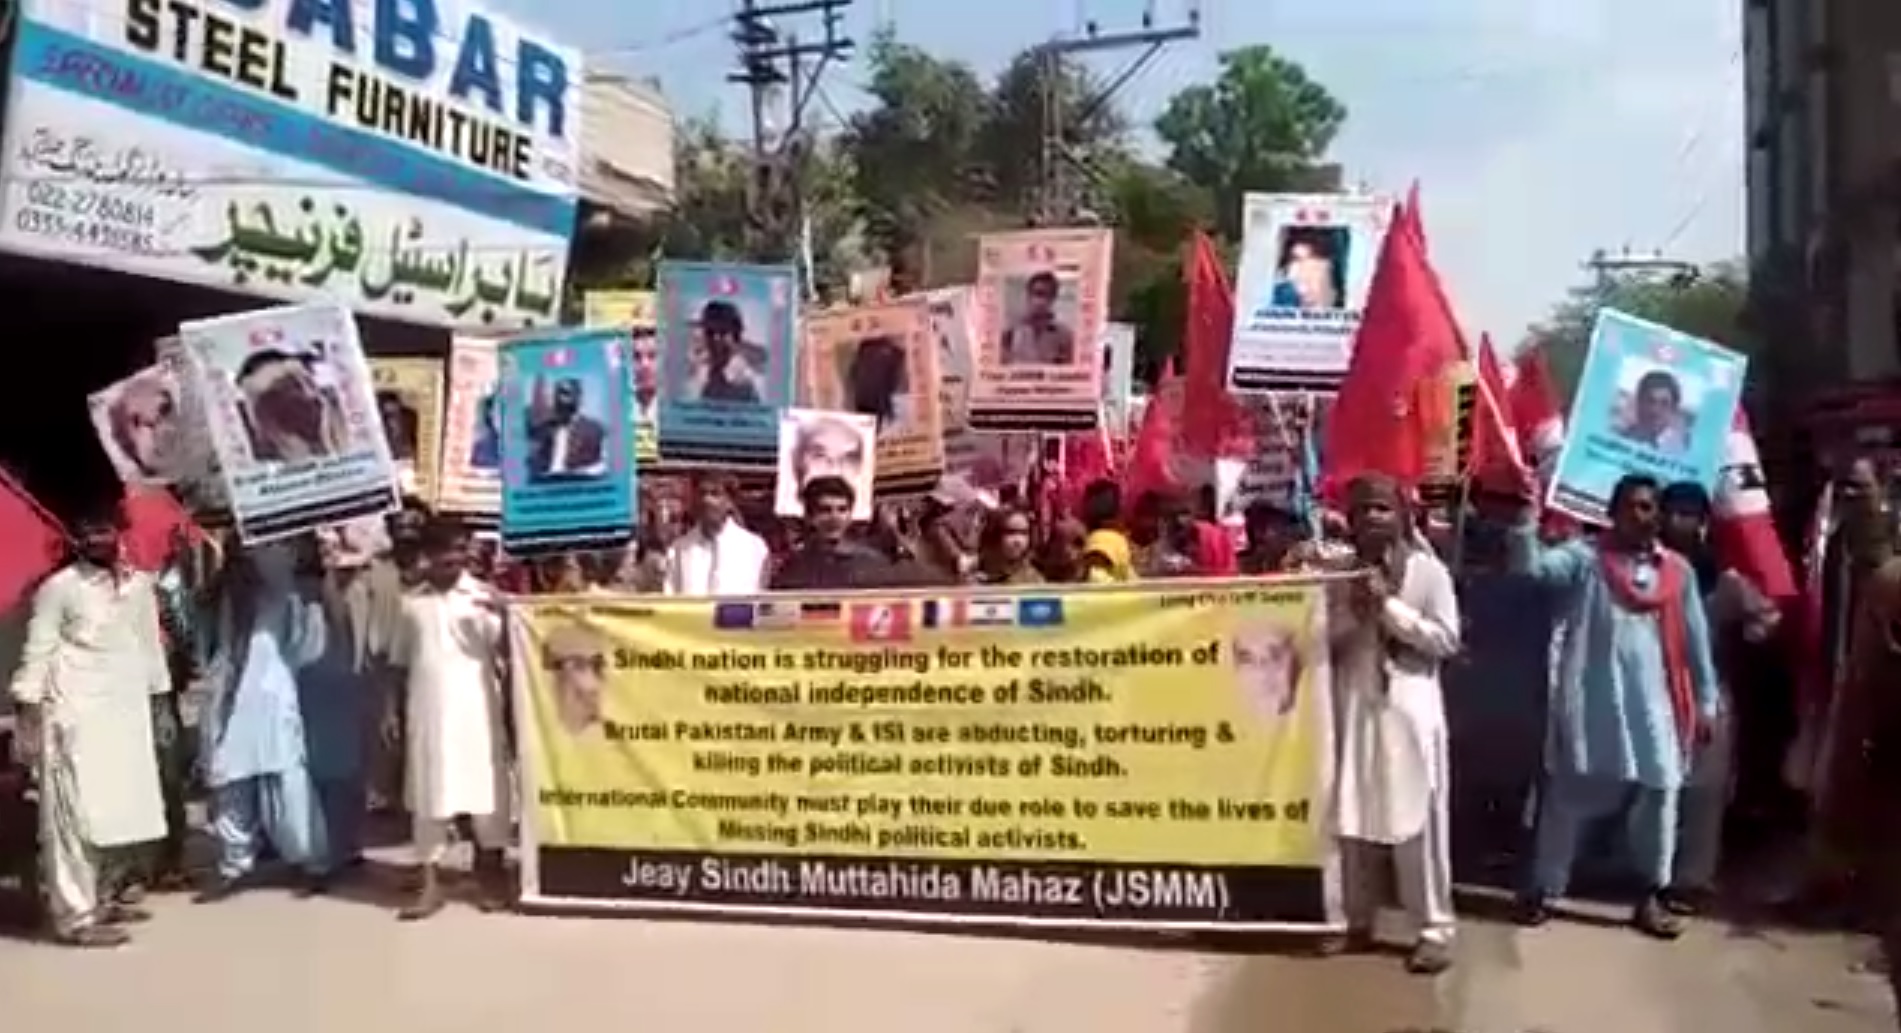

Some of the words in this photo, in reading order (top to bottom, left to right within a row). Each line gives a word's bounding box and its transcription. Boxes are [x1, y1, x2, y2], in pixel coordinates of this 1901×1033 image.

[226, 0, 568, 137] ABAR
[125, 2, 297, 101] STEEL
[328, 62, 532, 180] FURNITURE
[614, 648, 685, 670] Sindhi
[692, 648, 766, 670] nation
[774, 648, 795, 669] is
[803, 648, 929, 673] struggling
[937, 645, 973, 668] for
[981, 643, 1022, 668] the
[1031, 643, 1182, 667] restoration
[1192, 641, 1220, 666] of
[704, 682, 800, 704] national
[809, 680, 985, 708] independence
[993, 679, 1018, 703] of
[1028, 679, 1112, 703] Sindh.
[603, 720, 668, 742] Brutal
[675, 720, 776, 742] Pakistani
[783, 722, 843, 747] Army
[850, 722, 866, 743] &
[873, 721, 905, 744] ISI
[912, 725, 950, 743] are
[959, 722, 1086, 748] abducting,
[1094, 723, 1206, 748] torturing
[1215, 722, 1235, 743] &
[693, 752, 760, 776] killing
[767, 753, 802, 772] the
[809, 751, 901, 777] political
[909, 753, 1010, 776] activists
[1018, 755, 1042, 776] of
[1050, 755, 1129, 778] Sindh.
[671, 789, 789, 817] Community
[797, 795, 850, 812] must
[858, 794, 901, 820] play
[909, 795, 962, 815] their
[969, 797, 1011, 816] due
[1019, 798, 1065, 819] role
[1072, 799, 1097, 819] to
[1105, 802, 1161, 819] save
[1169, 799, 1211, 820] the
[1218, 799, 1276, 821] lives
[1285, 800, 1310, 823] of
[719, 819, 798, 847] Missing
[804, 822, 871, 845] Sindhi
[878, 824, 970, 848] political
[977, 827, 1087, 851] activists.
[621, 856, 691, 896] Jeay
[701, 857, 790, 894] Sindh
[800, 860, 961, 901] Muttahida
[971, 866, 1084, 903] Mahaz
[1094, 870, 1230, 914] (JSMM)
